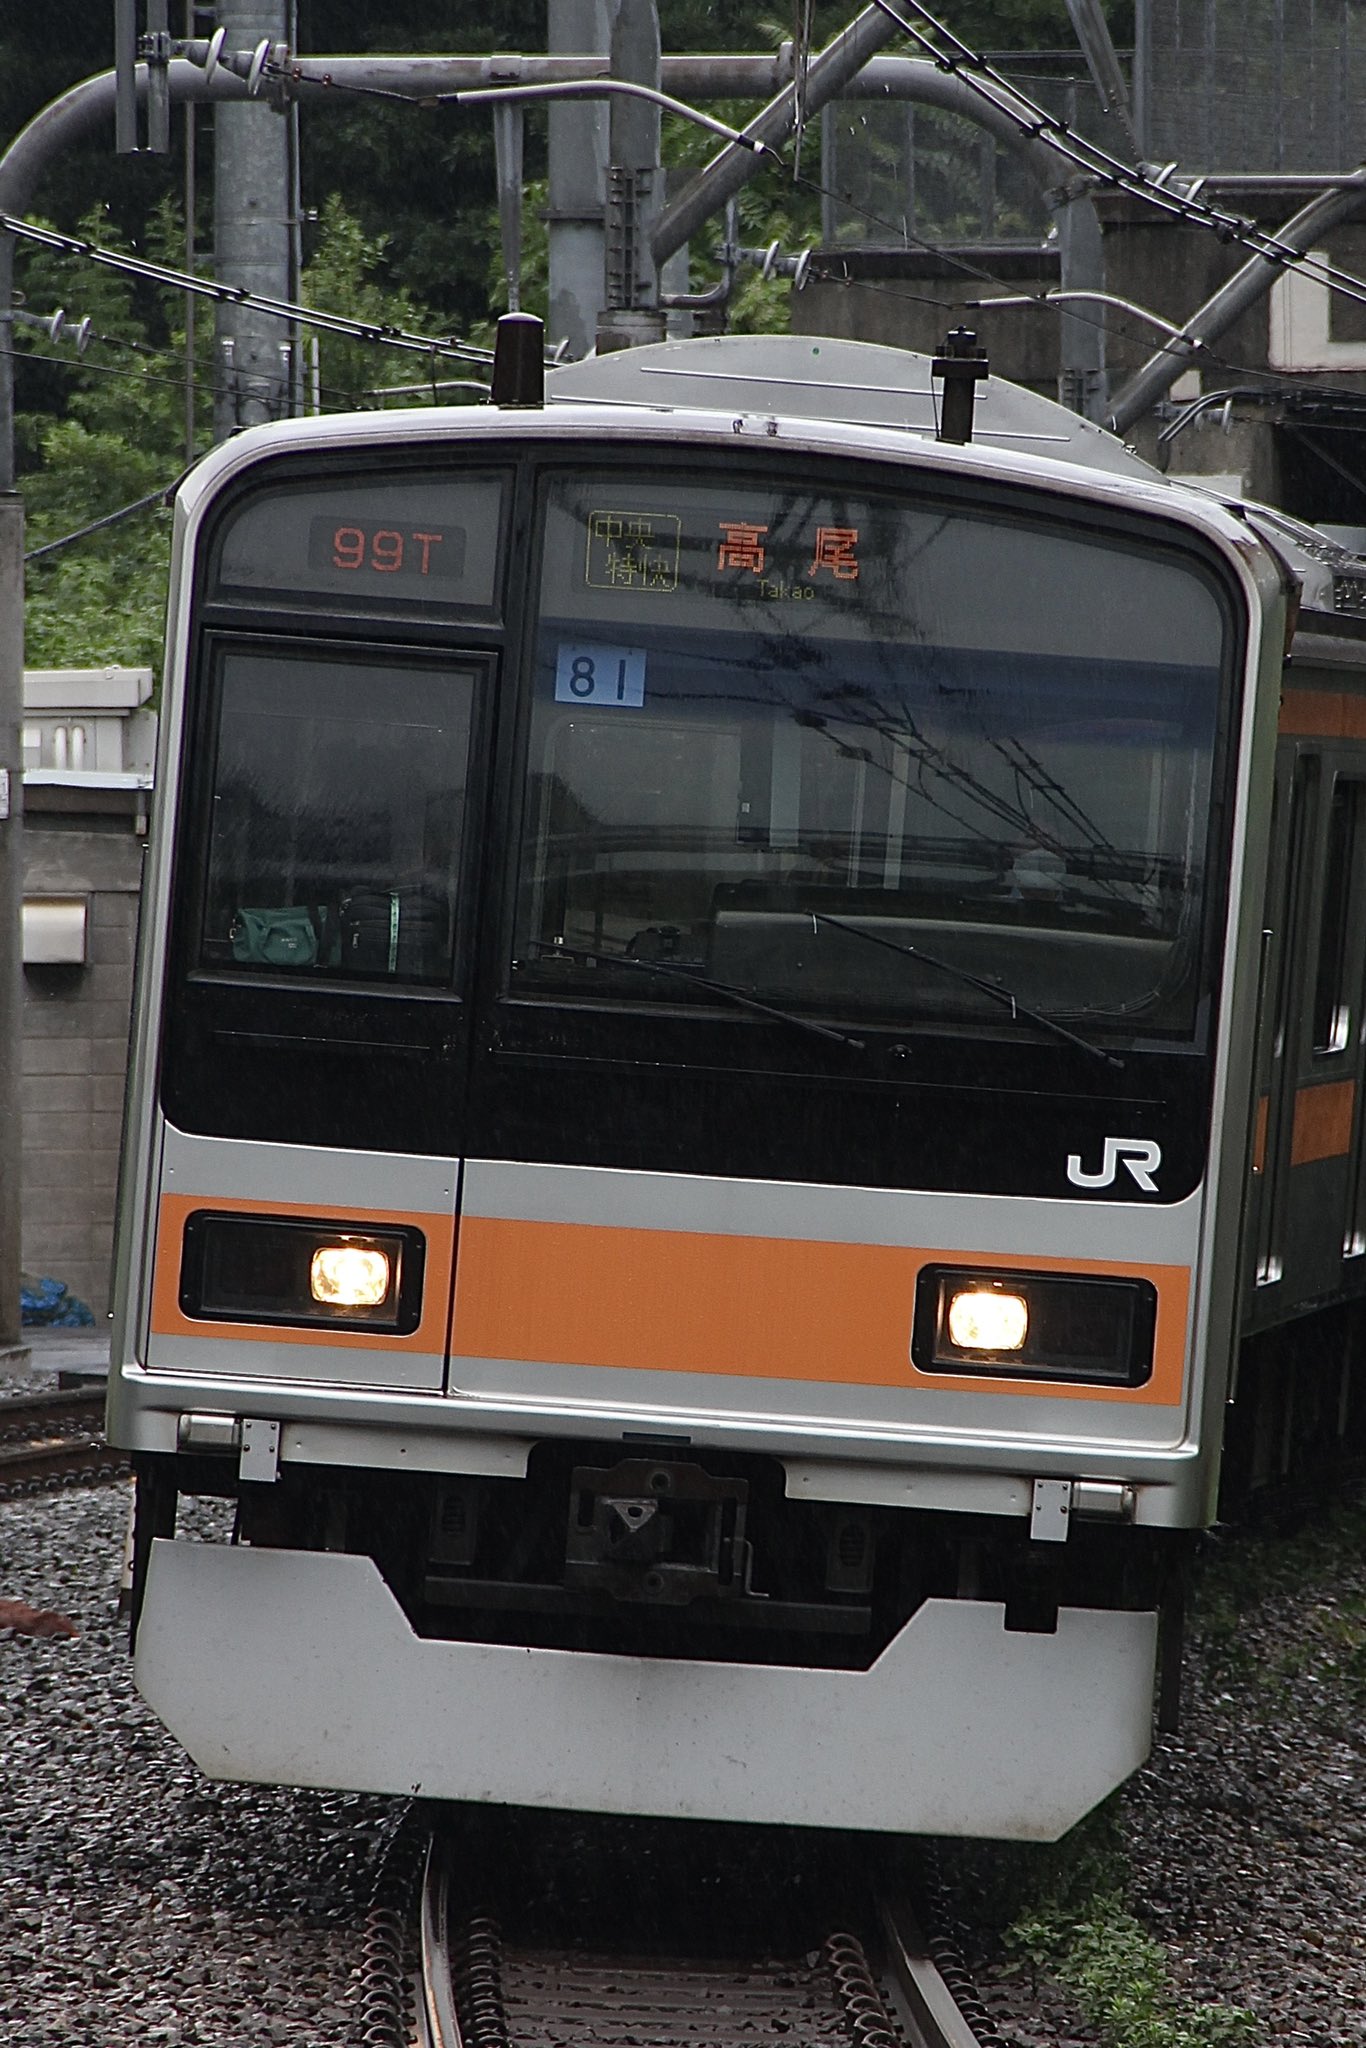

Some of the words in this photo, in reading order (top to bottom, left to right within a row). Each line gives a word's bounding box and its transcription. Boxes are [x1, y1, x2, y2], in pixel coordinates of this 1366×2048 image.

[333, 527, 443, 576] 99T
[595, 515, 655, 549] 中央
[717, 522, 859, 580] 高尾
[605, 552, 671, 587] 特快
[757, 579, 815, 600] Takao
[569, 656, 626, 701] 81
[1067, 1137, 1161, 1192] JR
